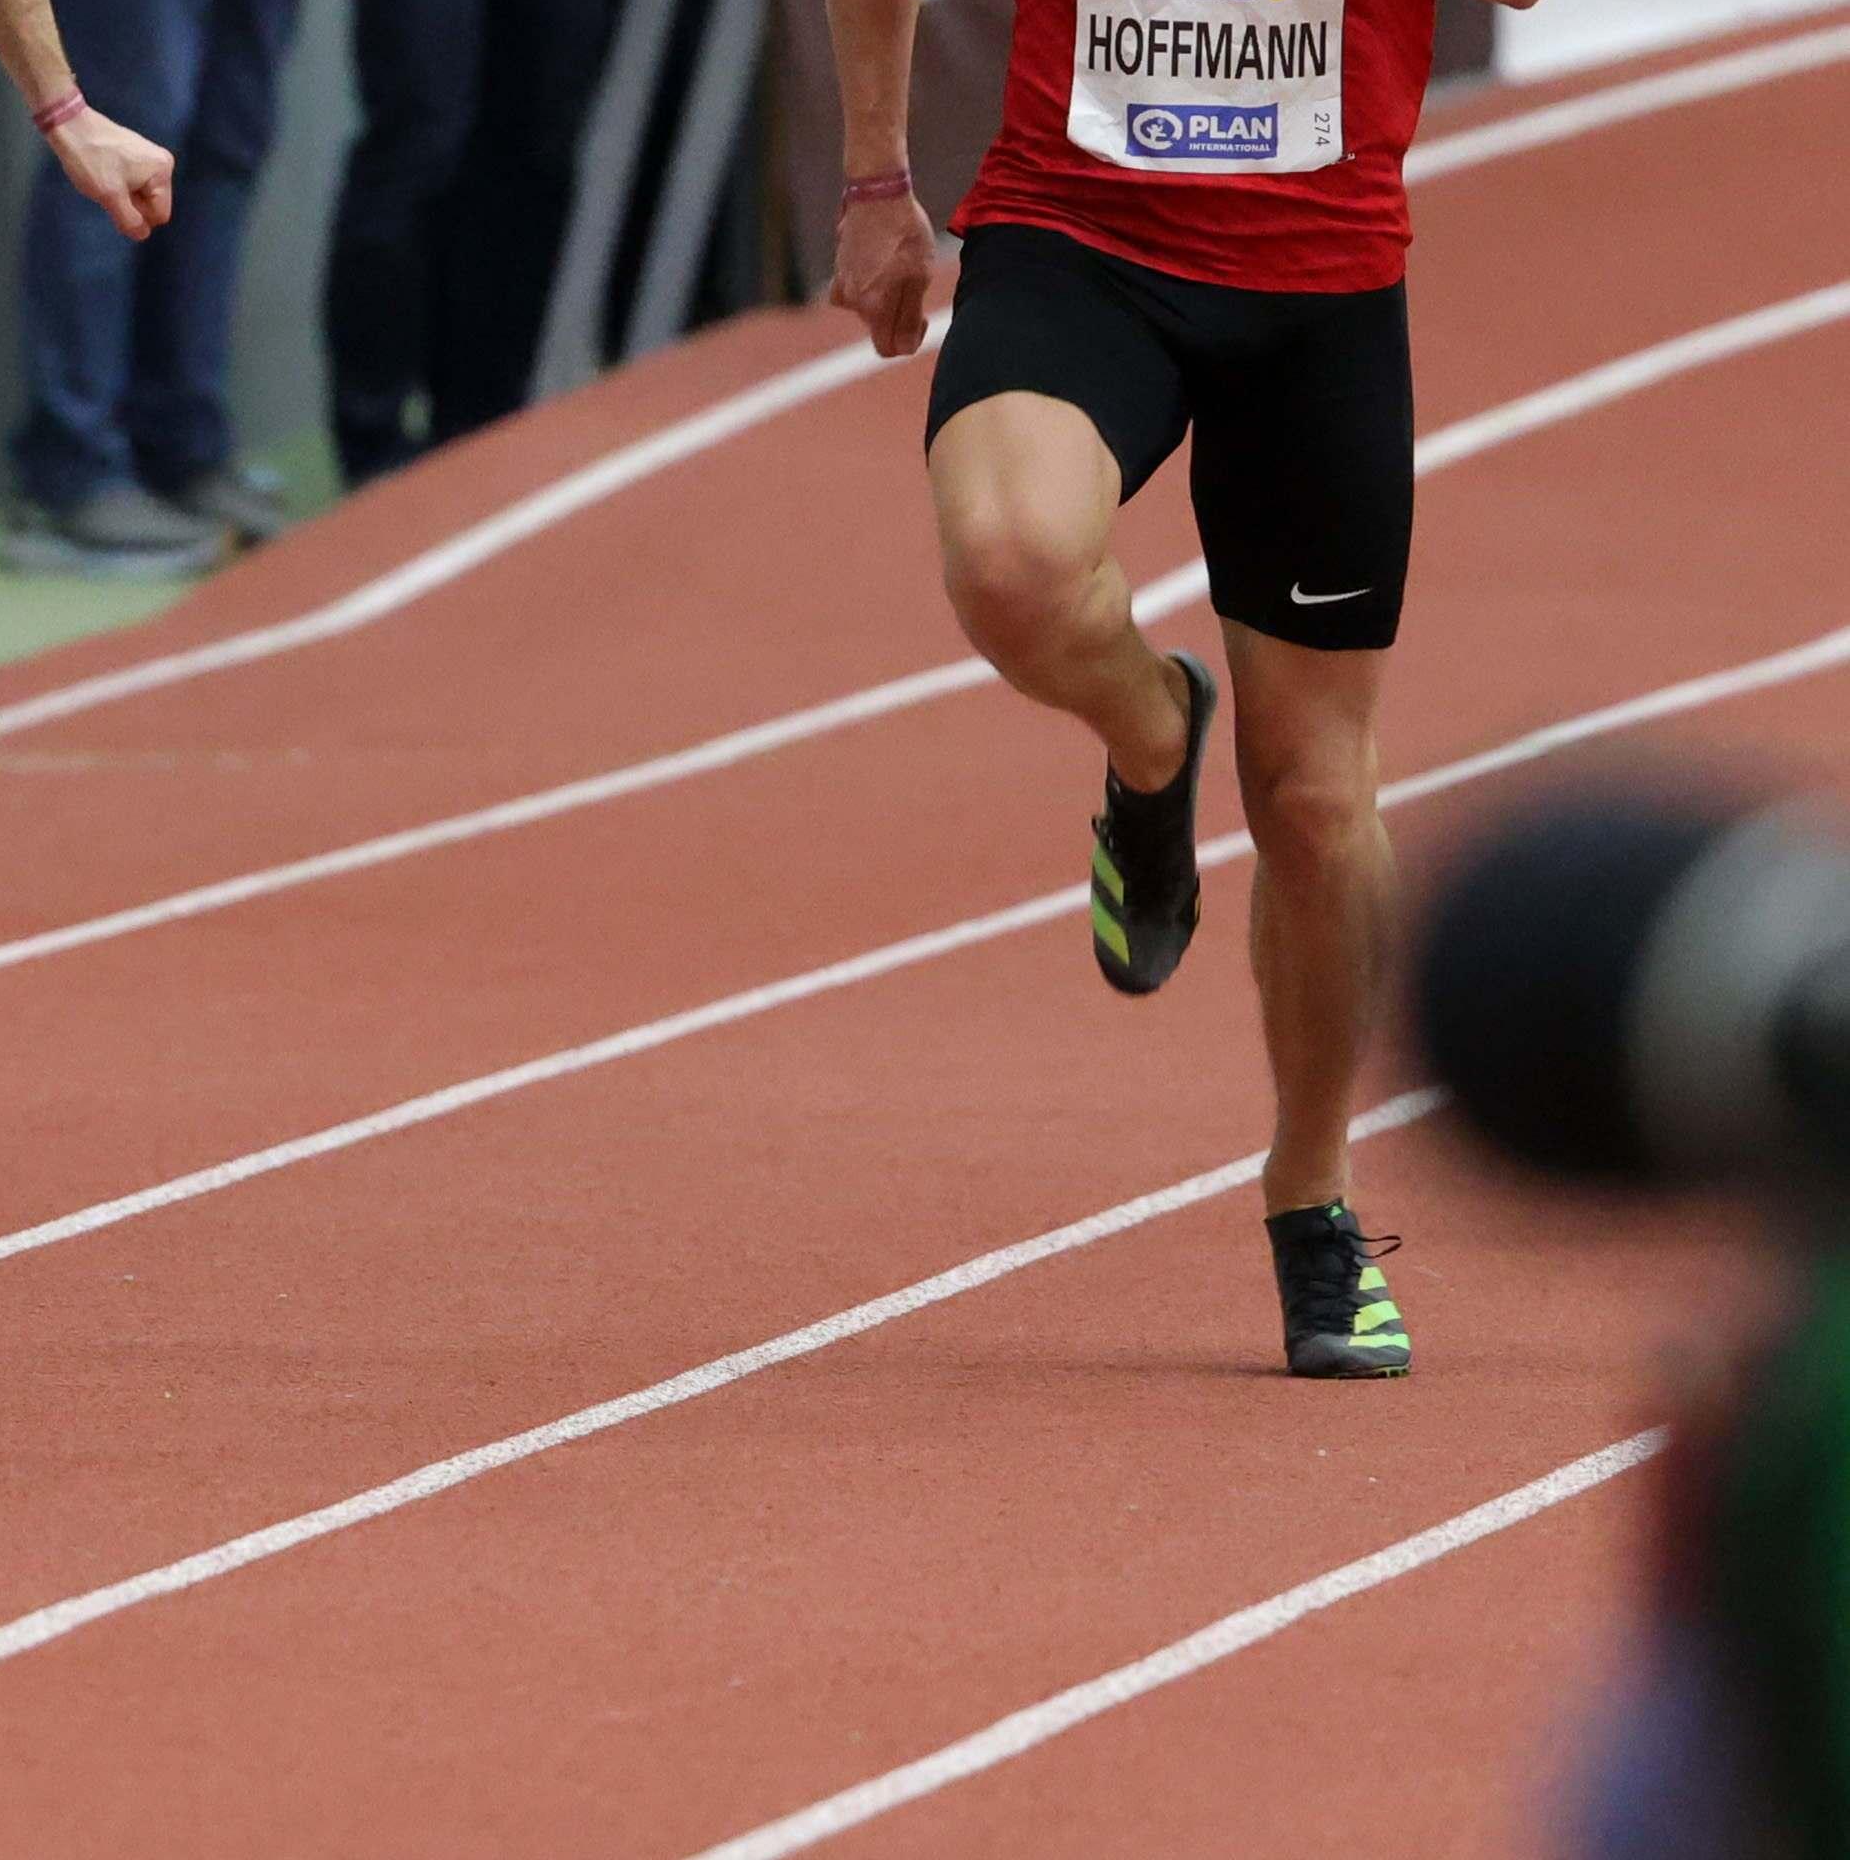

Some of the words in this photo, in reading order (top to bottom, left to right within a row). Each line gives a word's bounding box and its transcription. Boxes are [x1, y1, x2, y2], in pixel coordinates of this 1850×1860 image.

[1088, 14, 1327, 81] HOFFMANN
[1189, 115, 1273, 140] PLAN
[1314, 112, 1331, 146] 274
[1188, 142, 1270, 152] INTERNATIONAL
